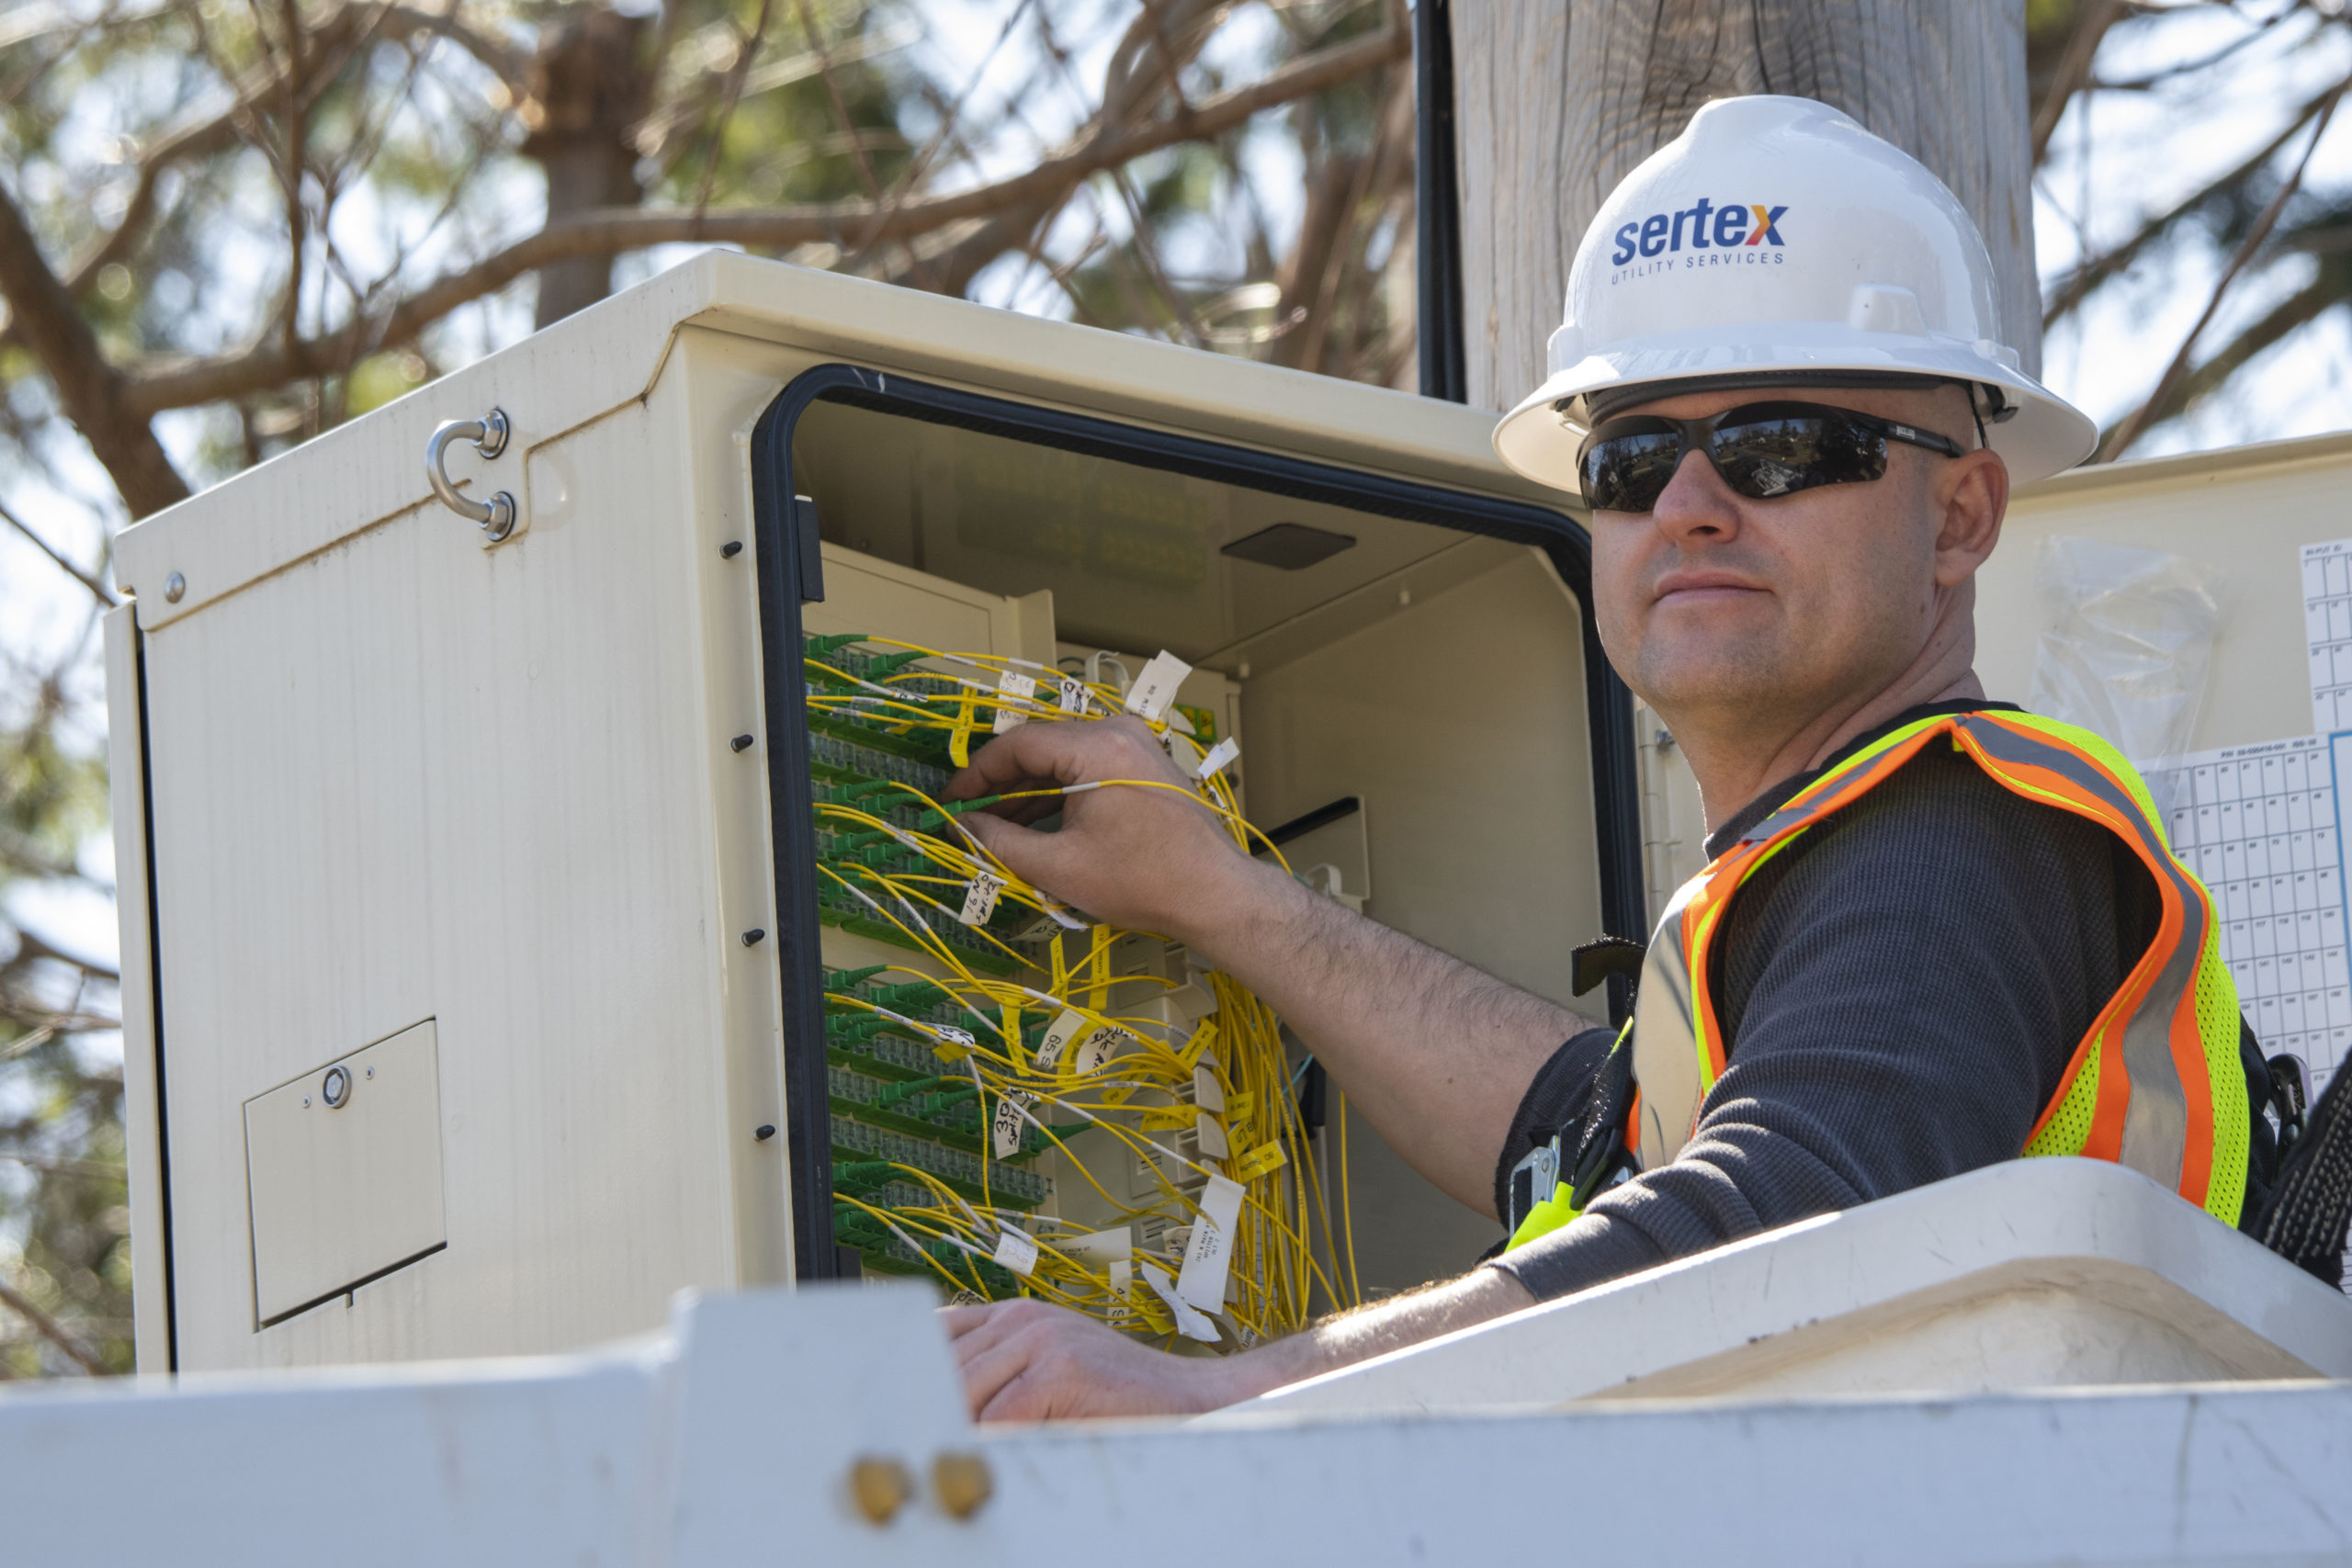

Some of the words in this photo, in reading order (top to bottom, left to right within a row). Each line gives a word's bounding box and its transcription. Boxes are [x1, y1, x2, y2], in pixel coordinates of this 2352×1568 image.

[1612, 197, 1789, 266] sertex
[1611, 260, 1675, 286] UTILITY
[1687, 253, 1783, 268] SERVICES
[1046, 1034, 1062, 1052] 65
